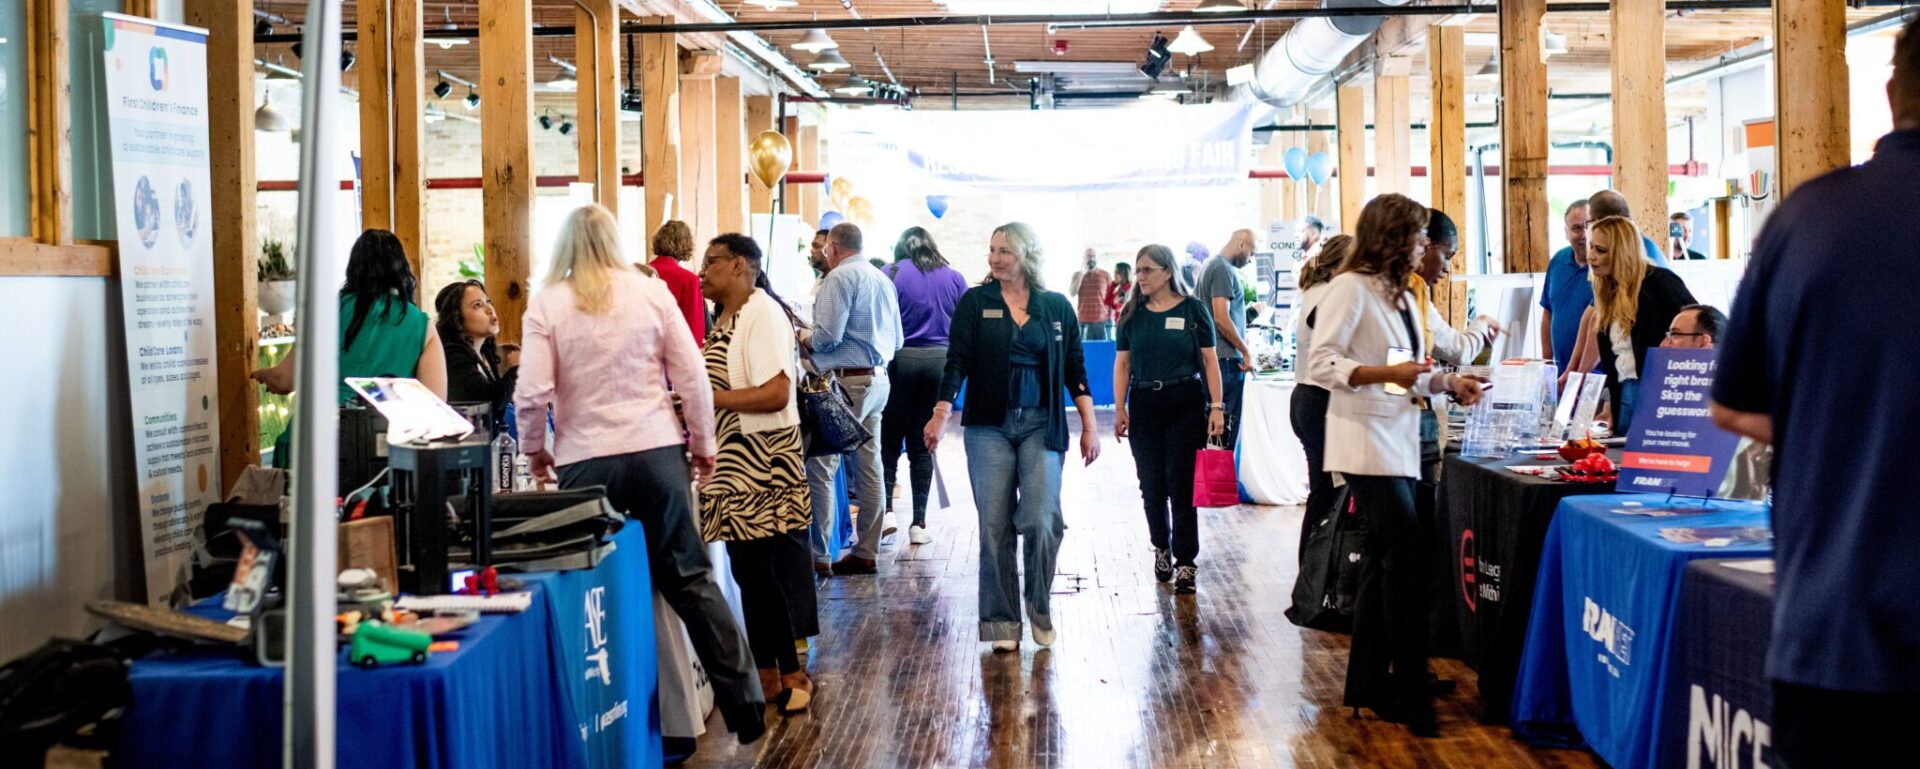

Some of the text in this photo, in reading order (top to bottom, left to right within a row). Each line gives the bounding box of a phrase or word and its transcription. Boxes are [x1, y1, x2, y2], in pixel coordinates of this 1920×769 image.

[122, 96, 138, 108] First
[174, 102, 199, 117] Finance
[1188, 141, 1234, 168] FAIR
[1667, 359, 1708, 374] Looking
[1663, 374, 1690, 389] right
[1660, 389, 1702, 404] Skip the
[1645, 429, 1697, 440] You're looking for
[1642, 439, 1656, 447] your
[1656, 439, 1671, 447] next
[502, 454, 510, 488] essentia
